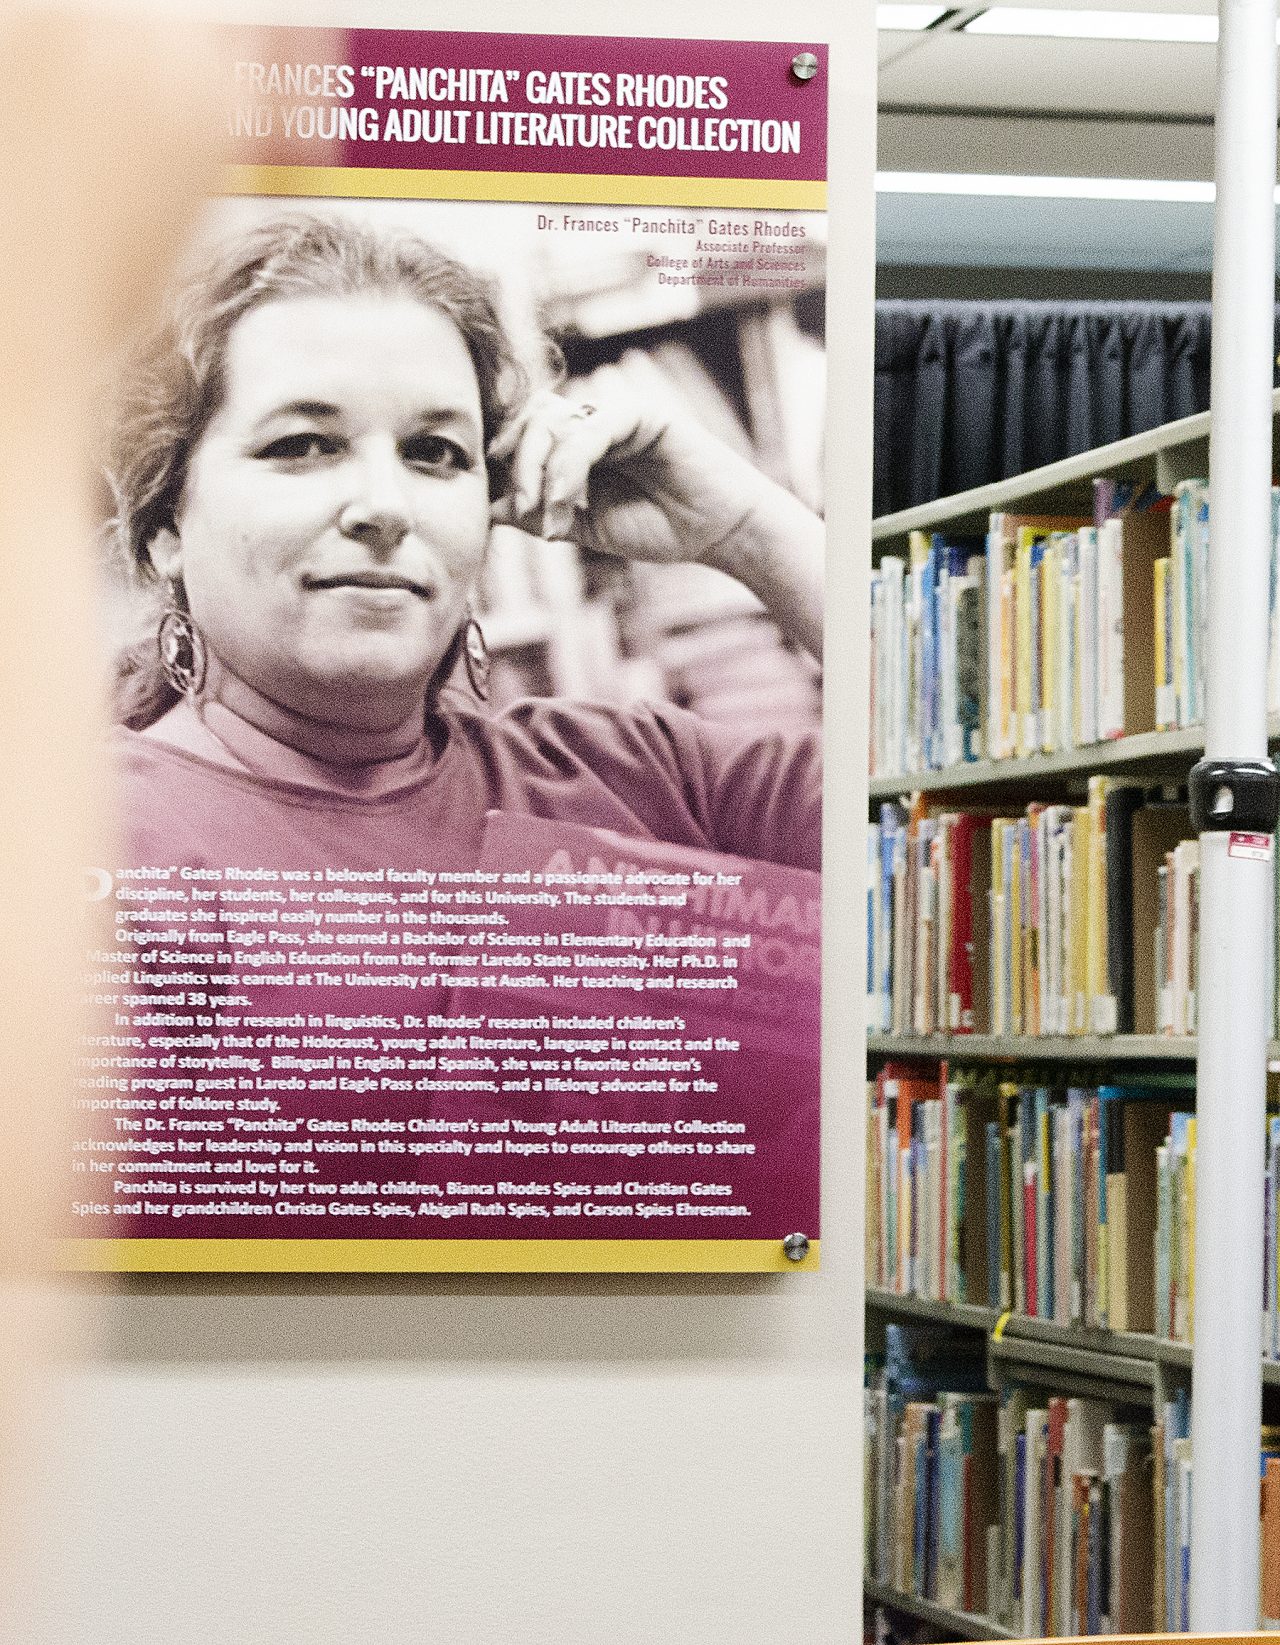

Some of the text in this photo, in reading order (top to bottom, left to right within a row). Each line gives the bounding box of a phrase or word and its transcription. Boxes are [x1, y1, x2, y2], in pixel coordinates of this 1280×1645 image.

[235, 62, 355, 98] FRANCES
[526, 69, 611, 106] GATES
[617, 72, 729, 109] RHODES
[281, 106, 379, 142] YOUNG
[384, 109, 471, 144] ADULT
[476, 114, 633, 150] LITERATURE
[638, 118, 802, 155] COLLECTION
[537, 215, 558, 231] Dr.
[563, 216, 619, 233] Frances
[709, 219, 749, 236] Gates
[754, 220, 806, 238] Rhodes
[696, 240, 806, 255] Associate Professor
[647, 255, 689, 270] College
[692, 257, 703, 270] of
[707, 257, 729, 270] Arts
[757, 258, 806, 272] Sciences
[658, 272, 806, 289] Department of Humanities
[116, 885, 686, 908] discipline, her students, her colleagues, and for this University. The students and
[114, 906, 508, 927] graduates she inspired easily number in the thousands.
[116, 927, 186, 947] Originally
[188, 927, 224, 944] from
[226, 928, 266, 948] Eagle
[268, 928, 304, 946] Pass,
[308, 928, 334, 944] she
[336, 928, 388, 944] earned
[402, 929, 466, 945] Bachelor
[468, 929, 484, 945] of
[488, 929, 542, 945] Science
[544, 929, 558, 946] in
[562, 930, 642, 950] Elementary
[646, 930, 716, 946] Education
[722, 930, 750, 947] and
[116, 1010, 130, 1026] In
[132, 1010, 194, 1026] addition
[196, 1010, 212, 1027] to
[216, 1011, 240, 1027] her
[244, 1011, 306, 1027] research
[308, 1011, 322, 1028] in
[326, 1011, 400, 1032] linguistics,
[404, 1012, 424, 1028] Dr.
[488, 1012, 550, 1029] research
[552, 1013, 614, 1029] included
[132, 1076, 192, 1093] program
[196, 1073, 236, 1093] guest
[238, 1073, 252, 1089] in
[256, 1073, 306, 1090] Laredo
[308, 1074, 336, 1090] and
[340, 1074, 378, 1094] Eagle
[380, 1074, 412, 1090] Pass
[416, 1074, 498, 1093] classrooms,
[502, 1075, 530, 1091] and
[544, 1075, 598, 1095] lifelong
[602, 1076, 666, 1092] advocate
[668, 1076, 690, 1092] for
[692, 1076, 718, 1092] the
[114, 1114, 142, 1130] The
[144, 1114, 164, 1130] Dr.
[168, 1114, 224, 1131] Frances
[306, 1115, 348, 1132] Gates
[352, 1116, 406, 1132] Rhodes
[482, 1116, 510, 1132] and
[512, 1116, 556, 1137] Young
[560, 1117, 598, 1133] Adult
[602, 1117, 672, 1133] Literature
[674, 1118, 746, 1134] Collection
[178, 1135, 202, 1152] her
[206, 1136, 282, 1156] leadership
[284, 1136, 312, 1152] and
[316, 1136, 358, 1152] vision
[360, 1136, 376, 1153] in
[378, 1136, 406, 1153] this
[408, 1137, 472, 1157] specialty
[474, 1137, 502, 1153] and
[506, 1137, 550, 1158] hopes
[552, 1137, 568, 1154] to
[570, 1141, 644, 1158] encourage
[648, 1138, 694, 1154] others
[696, 1138, 712, 1155] to
[716, 1138, 756, 1155] share
[72, 1155, 320, 1173] in her commitment and love for it.
[114, 1176, 732, 1199] Panchita is survived by her two adult children, Bianca Rhodes Spies and Christian Gates
[72, 1197, 750, 1221] Spies and her grandchildren Christa Gates Spies, Abigail Ruth Spies, and Carson Spies Ehresman.
